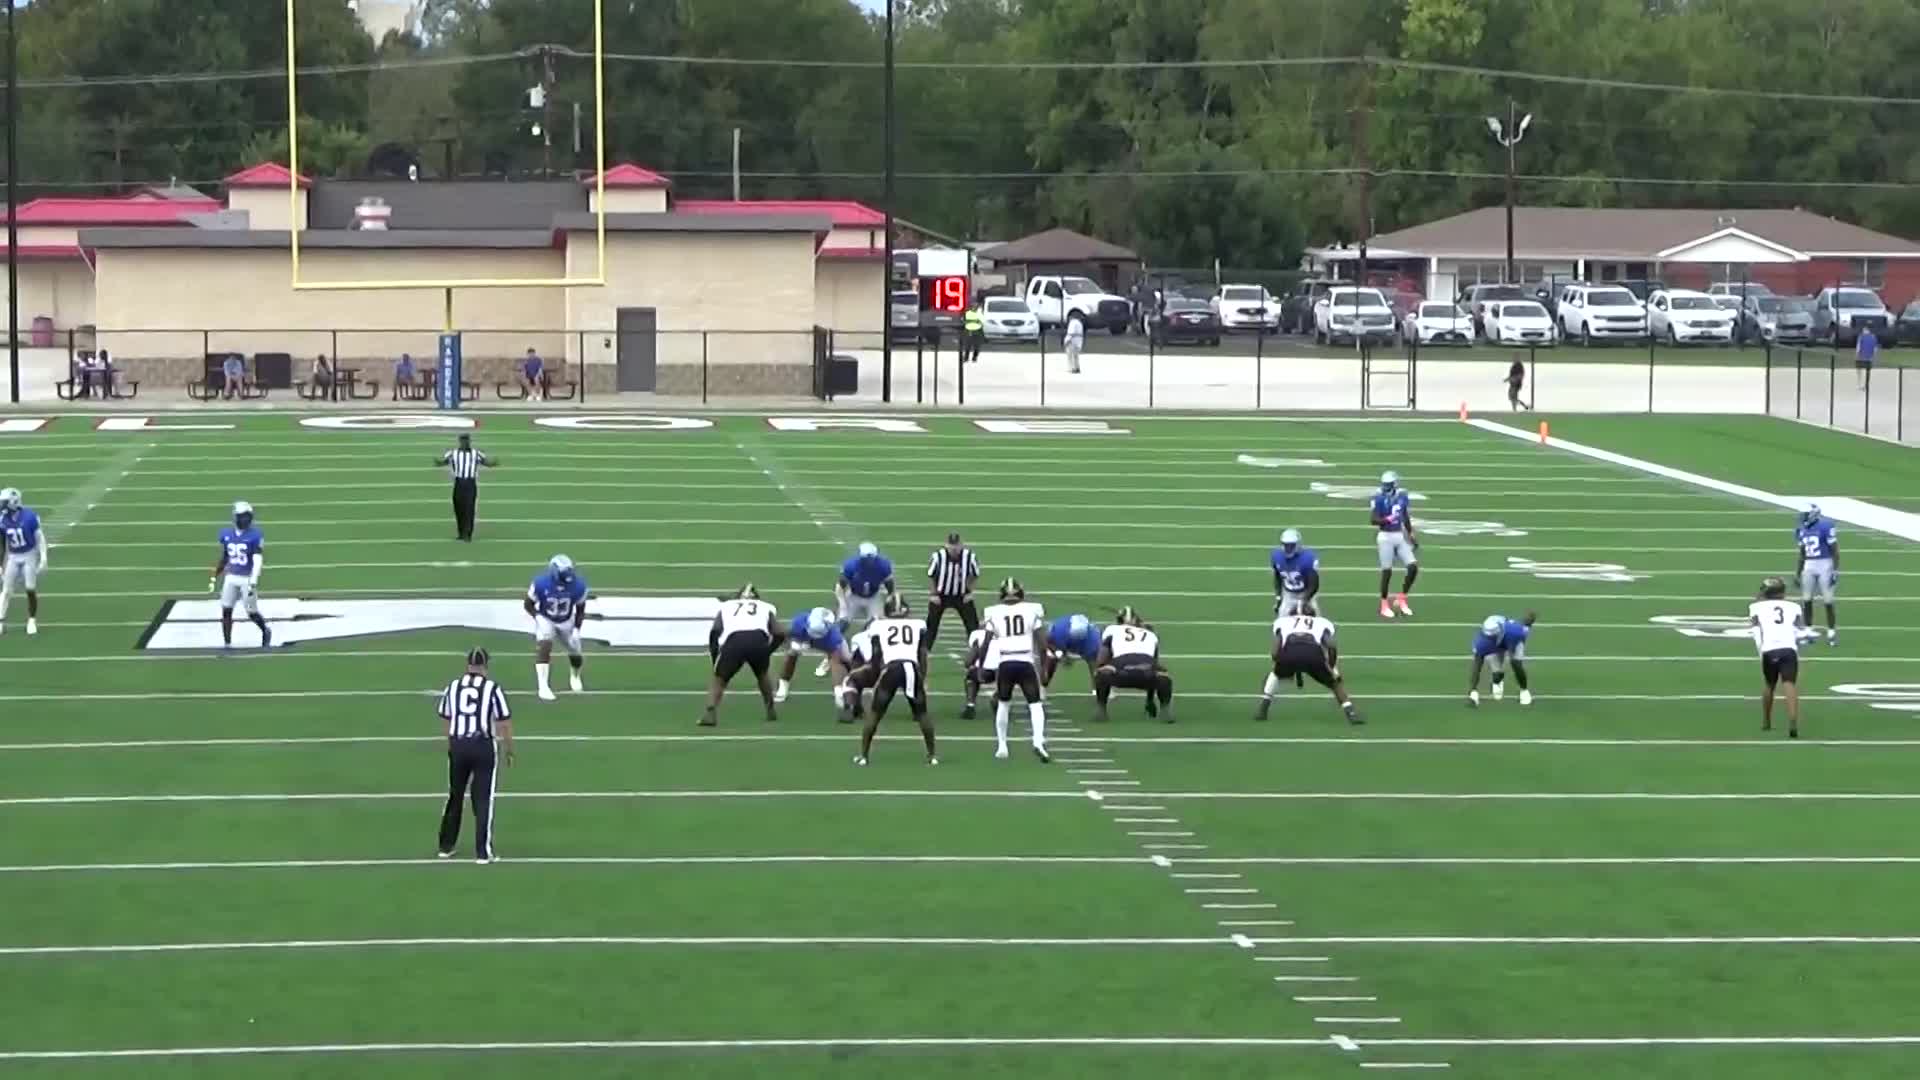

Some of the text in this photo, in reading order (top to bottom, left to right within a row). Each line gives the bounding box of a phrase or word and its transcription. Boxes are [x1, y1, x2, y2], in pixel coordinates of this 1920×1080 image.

[935, 277, 965, 311] 19
[732, 602, 758, 616] 73
[1774, 606, 1784, 625] 3
[1004, 614, 1025, 637] 10
[1292, 617, 1314, 630] 79
[887, 624, 913, 646] 20
[1125, 627, 1148, 642] 57
[459, 686, 479, 714] C
